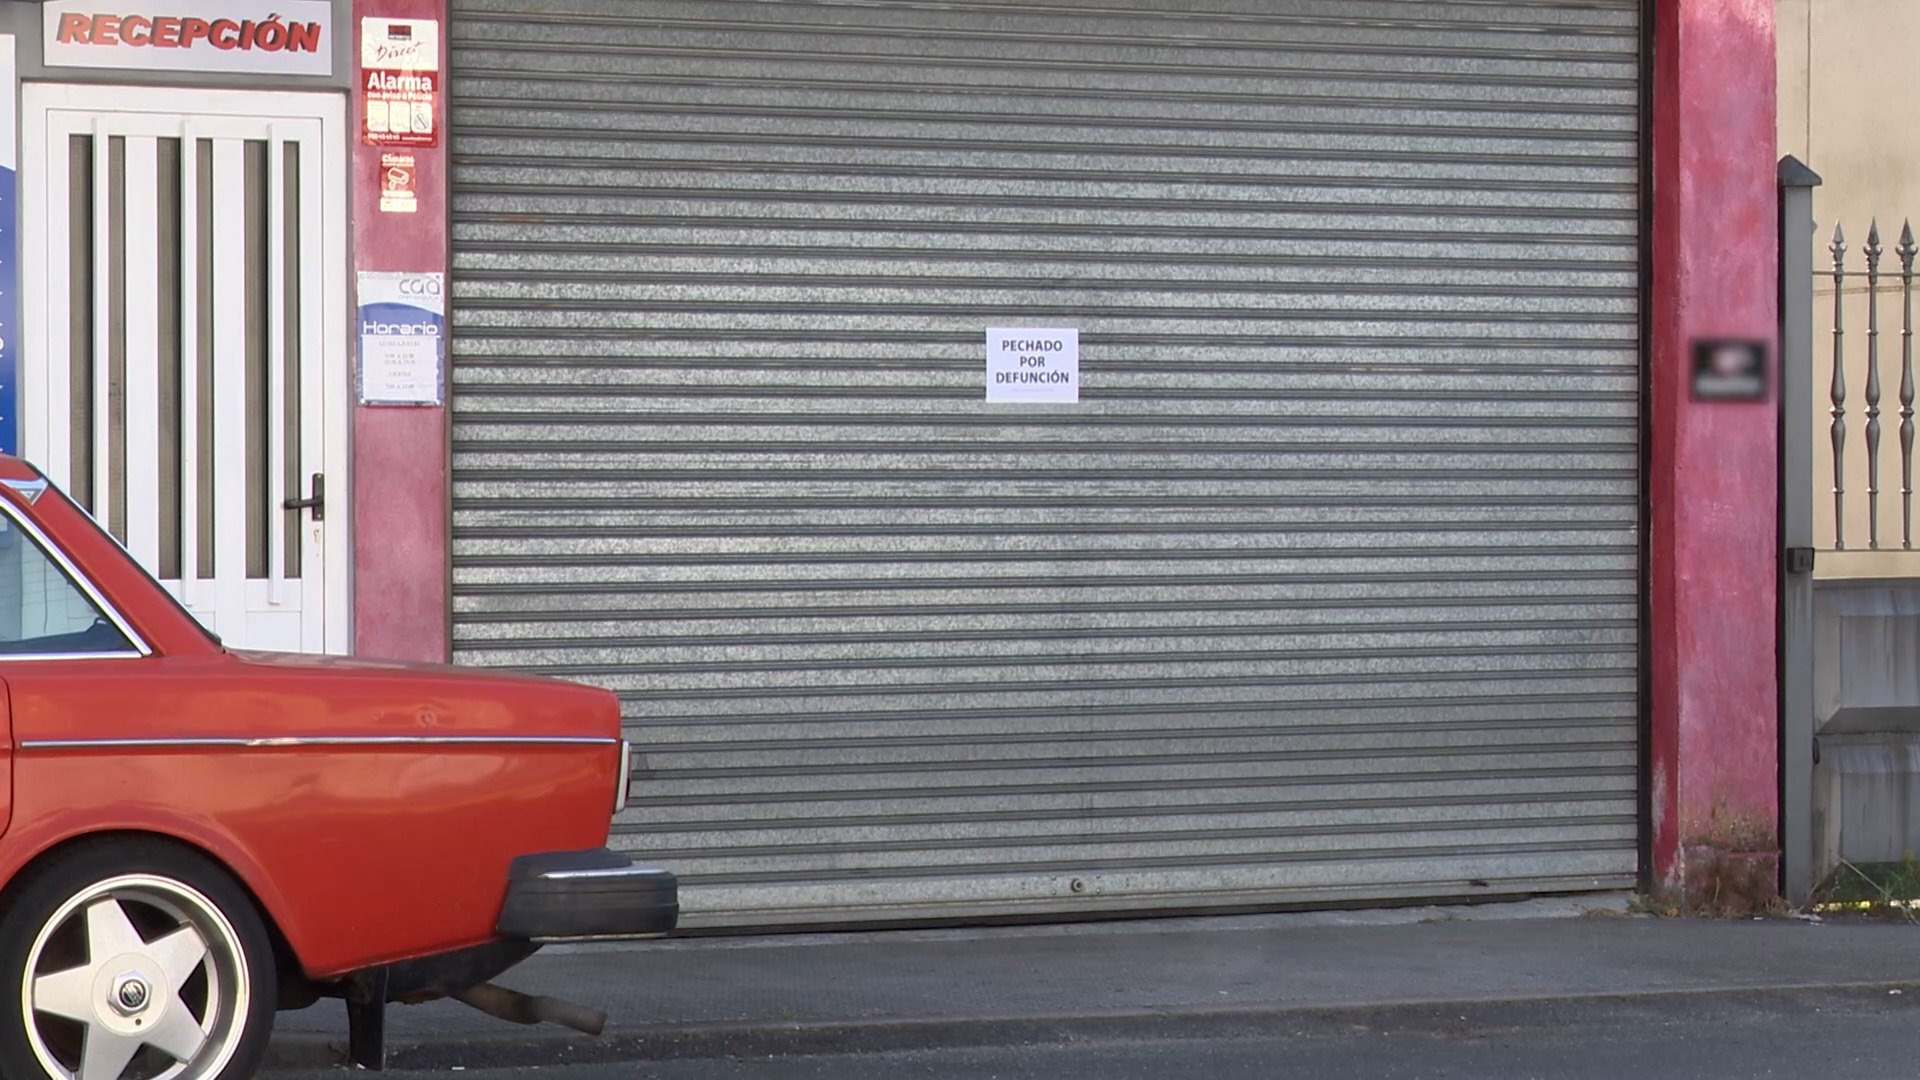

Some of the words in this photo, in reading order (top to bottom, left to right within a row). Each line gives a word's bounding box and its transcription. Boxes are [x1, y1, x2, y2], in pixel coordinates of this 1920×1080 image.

[57, 13, 321, 53] RECEPCIÓN
[367, 71, 432, 91] Alarma
[363, 320, 438, 335] Horario
[1002, 340, 1063, 352] PECHADO
[1020, 355, 1046, 367] POR
[996, 369, 1069, 384] DEFUNCIÓN
